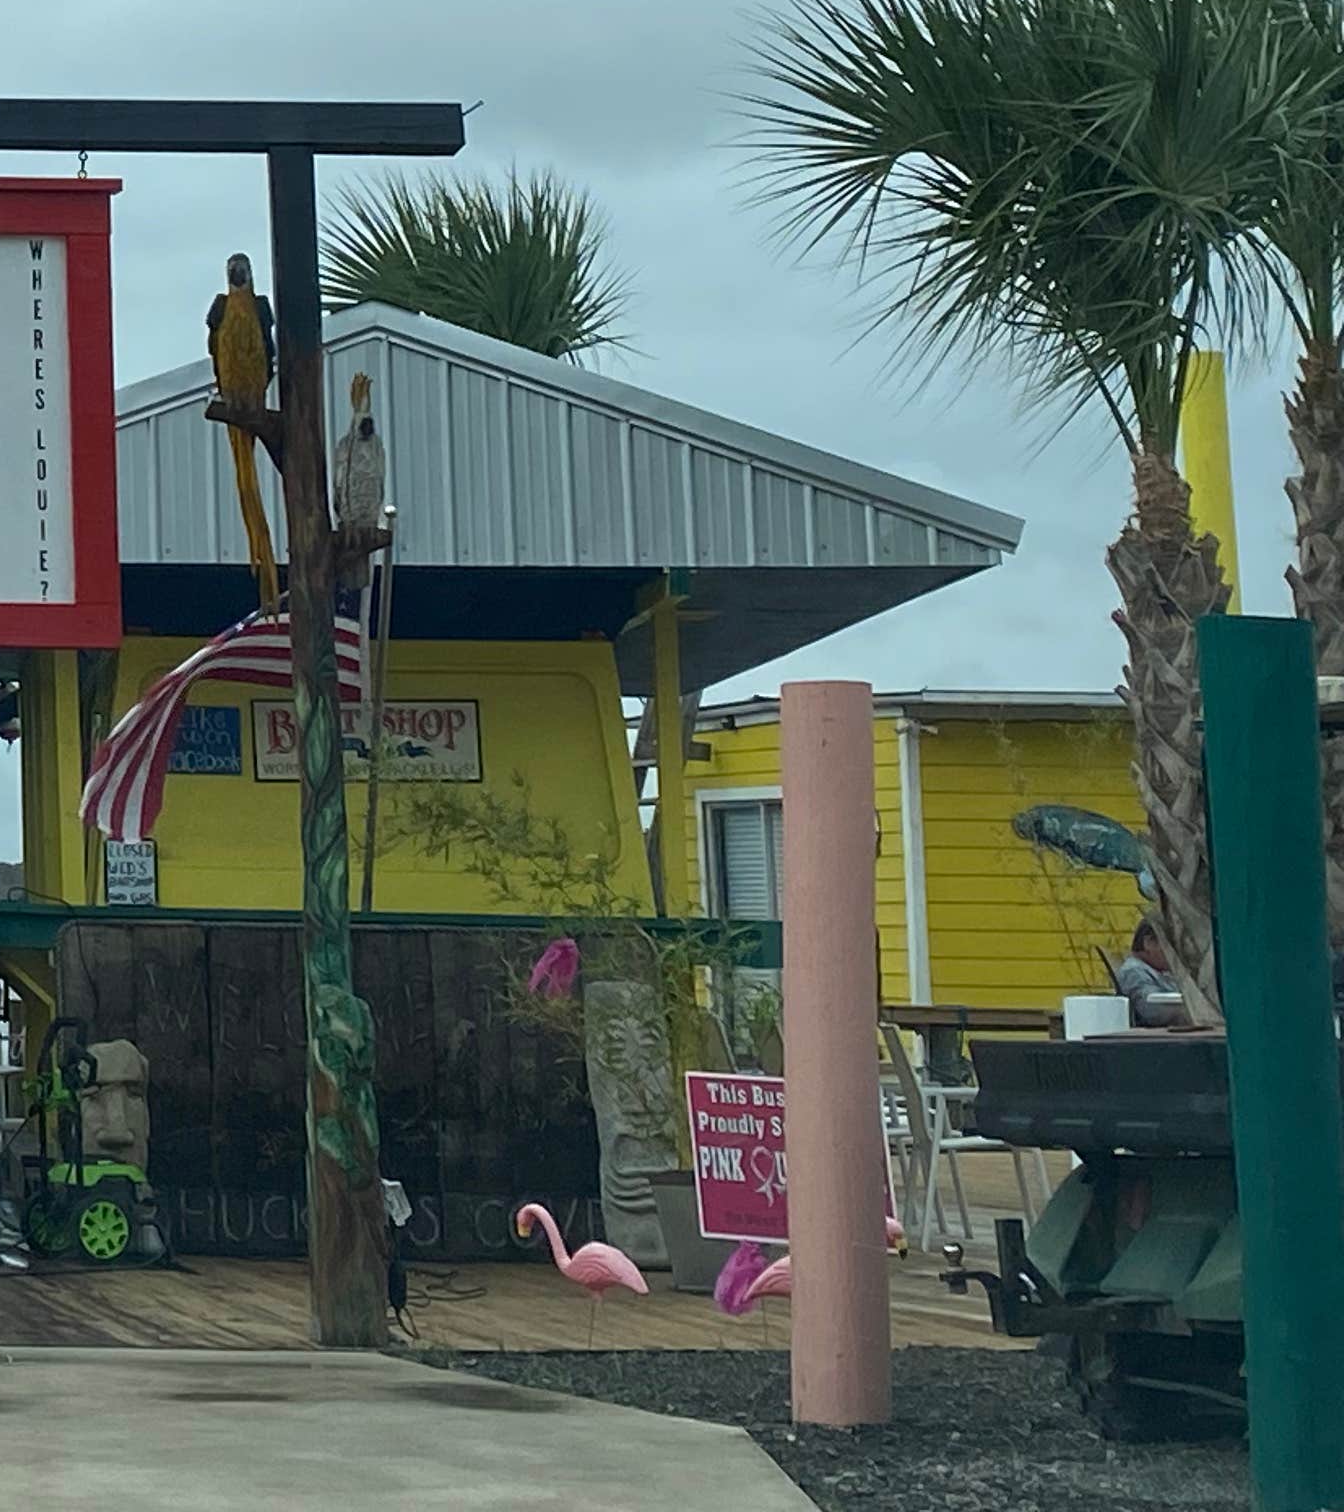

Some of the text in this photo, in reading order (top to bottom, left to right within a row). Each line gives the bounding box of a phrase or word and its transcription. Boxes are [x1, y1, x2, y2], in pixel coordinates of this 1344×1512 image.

[28, 239, 46, 410] WHERES
[35, 427, 50, 602] LOUIE?
[381, 707, 466, 751] SHOP
[143, 961, 428, 1054] WELCME
[706, 1082, 747, 1105] This
[697, 1111, 765, 1140] Proudly
[699, 1146, 745, 1182] PINK
